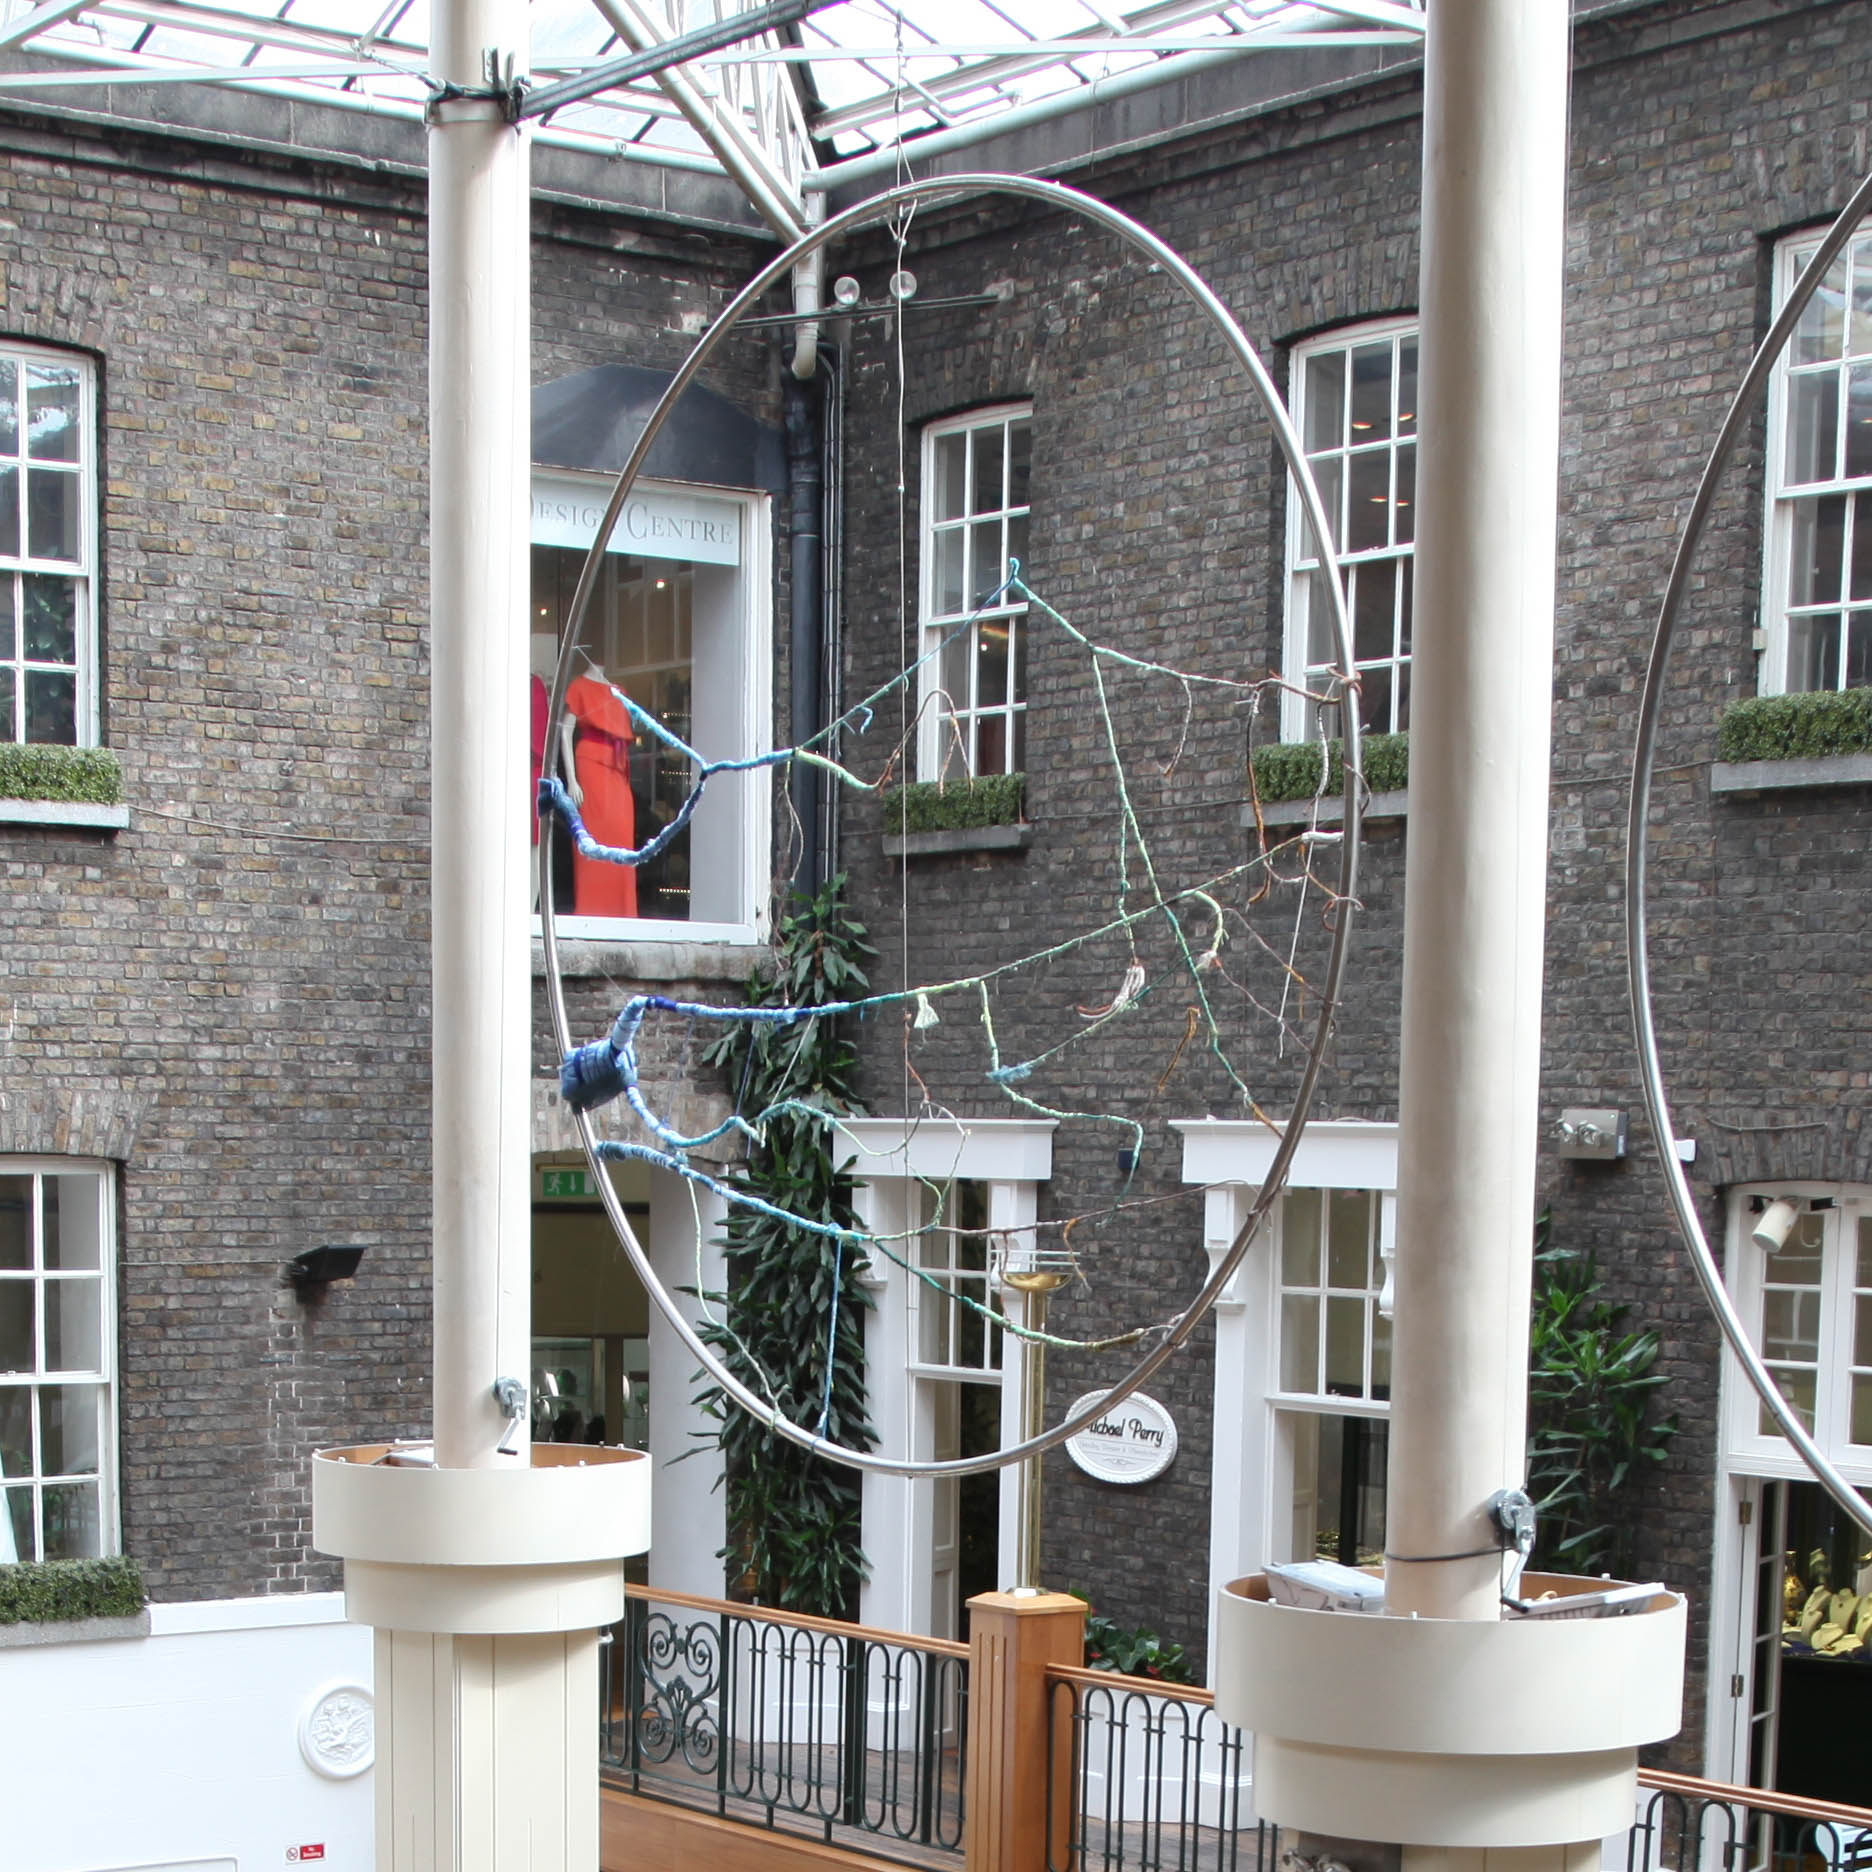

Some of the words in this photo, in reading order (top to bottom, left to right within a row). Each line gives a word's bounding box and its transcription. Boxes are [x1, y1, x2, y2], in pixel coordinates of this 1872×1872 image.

[531, 498, 603, 529] ESIG
[628, 502, 734, 546] CENTRE
[1089, 1415, 1126, 1437] ichael
[1128, 1417, 1164, 1448] Perry
